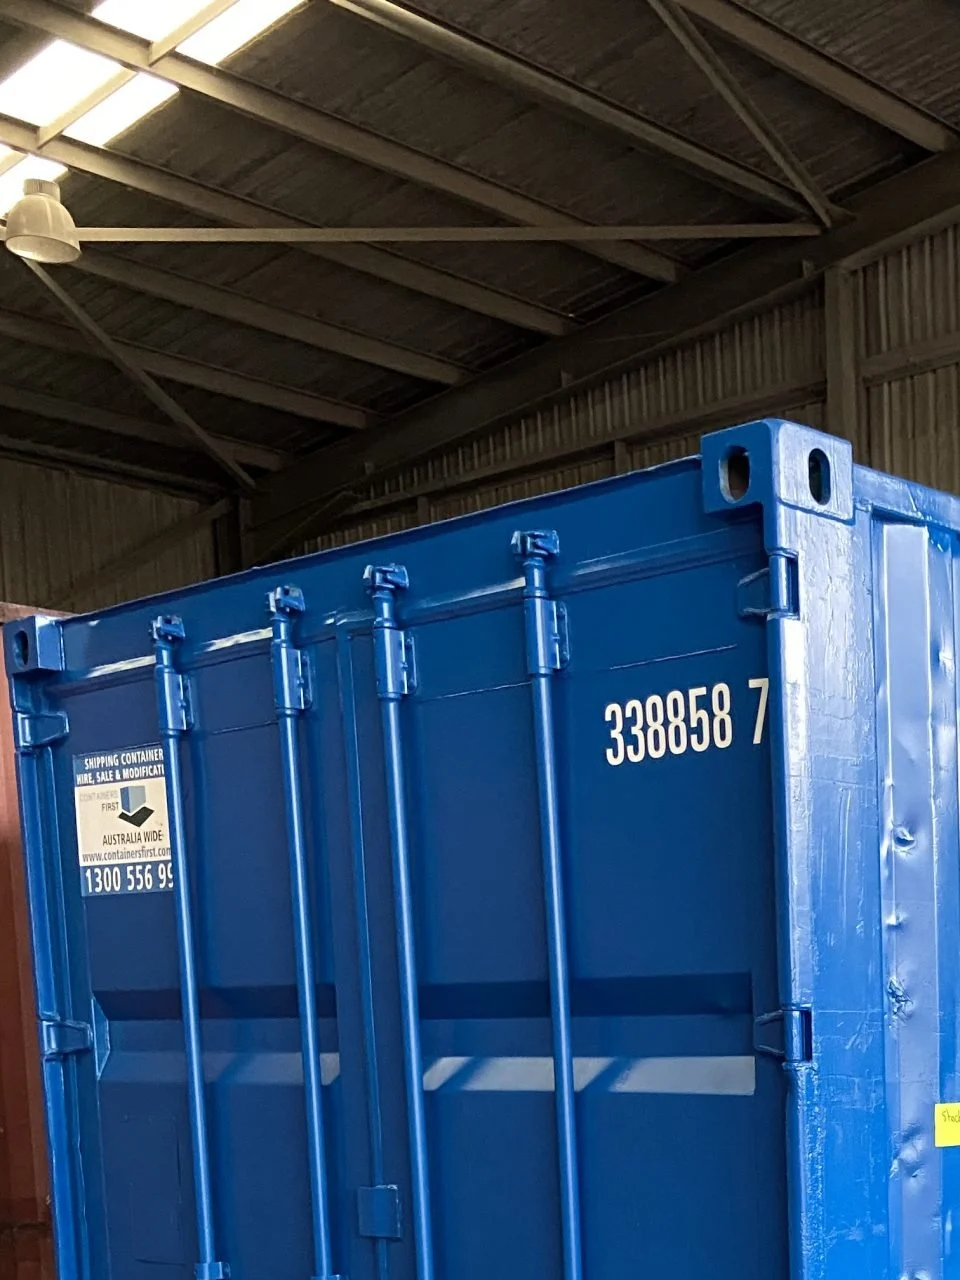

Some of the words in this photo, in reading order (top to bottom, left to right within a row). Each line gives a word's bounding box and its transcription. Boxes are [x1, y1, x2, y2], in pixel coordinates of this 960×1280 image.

[605, 682, 733, 766] 338858
[748, 677, 770, 745] 7
[84, 754, 119, 769] SHIPPING
[76, 773, 94, 785] HIRE,
[96, 771, 114, 782] SALE
[115, 770, 121, 780] &
[80, 790, 119, 801] CONTAINERS
[101, 802, 119, 812] FIRST
[102, 831, 142, 845] AUSTRALIA
[143, 829, 163, 842] WIDE
[85, 866, 121, 893] 1300
[127, 864, 153, 891] 556
